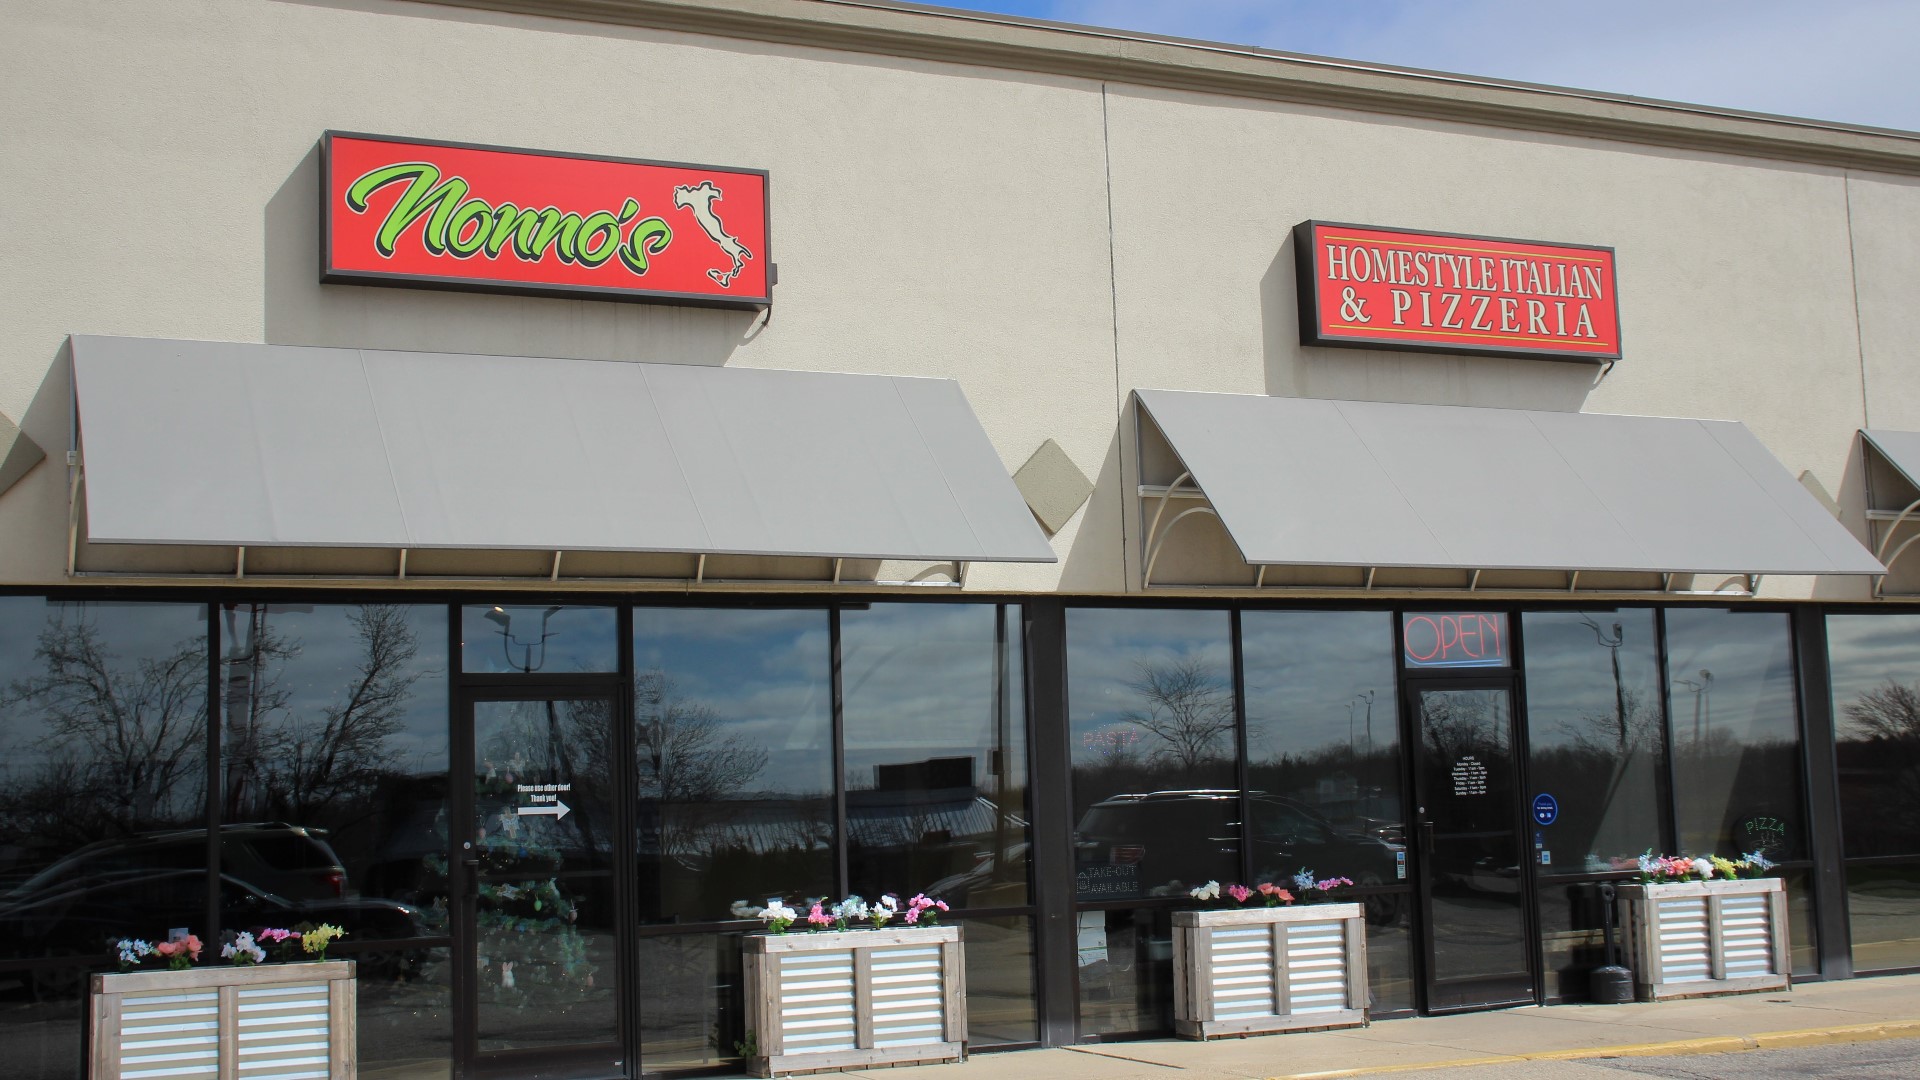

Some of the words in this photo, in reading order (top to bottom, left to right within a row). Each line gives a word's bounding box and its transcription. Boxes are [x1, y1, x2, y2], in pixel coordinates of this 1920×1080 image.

[345, 161, 673, 277] Nonno's
[1325, 243, 1498, 293] HOMESTYLE
[1500, 258, 1603, 301] ITALIAN
[1340, 286, 1372, 324] &
[1390, 288, 1599, 339] PIZZERIA
[1403, 613, 1501, 661] OPEN
[1083, 730, 1141, 748] PASTA
[518, 784, 534, 792] Please
[544, 784, 557, 792] other
[558, 783, 570, 791] door!
[530, 794, 545, 802] Thank
[546, 794, 557, 802] you!
[1745, 817, 1785, 836] PIZZA
[1088, 864, 1138, 878] TAKE-OUT
[1090, 881, 1139, 894] AVAILABLE
